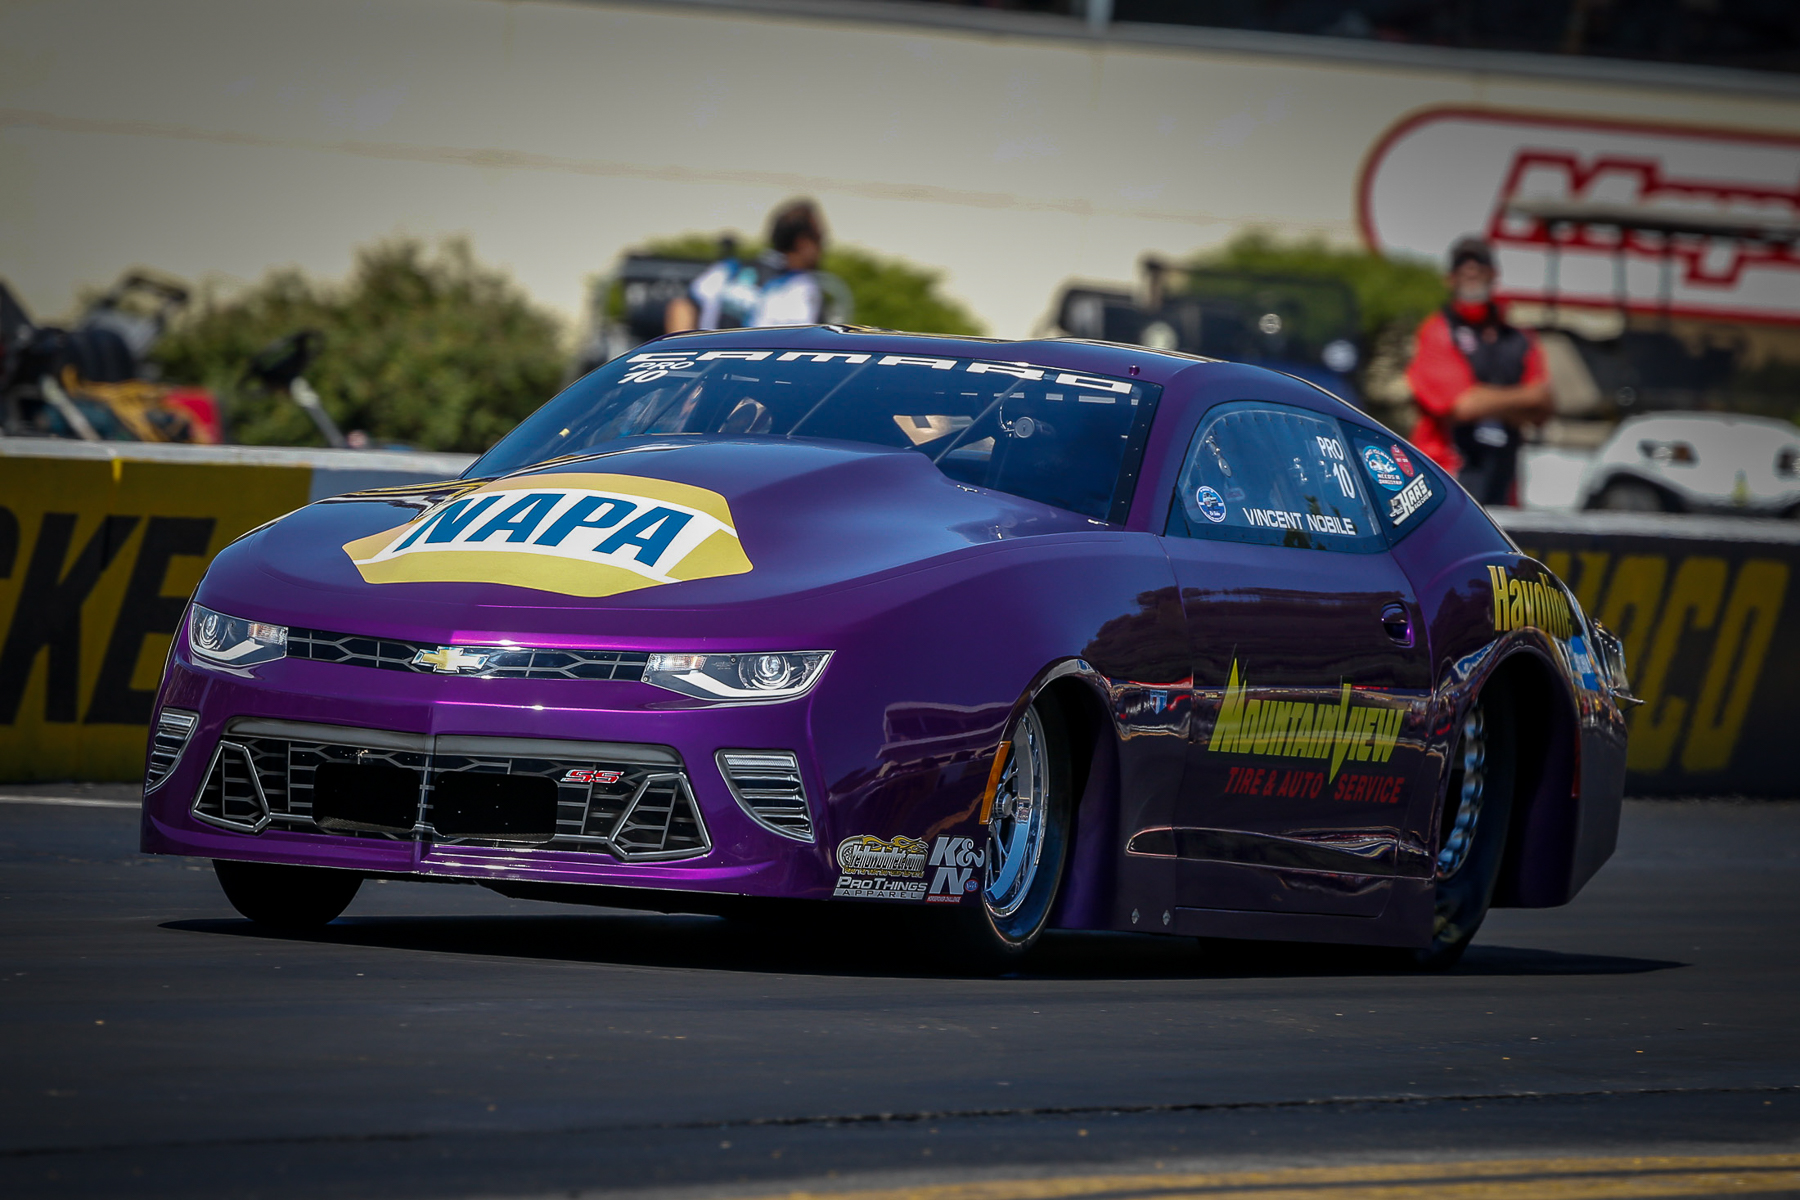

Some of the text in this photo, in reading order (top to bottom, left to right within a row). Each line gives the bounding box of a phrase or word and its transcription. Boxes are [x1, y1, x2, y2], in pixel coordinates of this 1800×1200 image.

[618, 370, 669, 384] 10
[626, 351, 1133, 395] CAMARO
[629, 361, 696, 372] PRO
[1316, 436, 1345, 461] PRO
[1333, 463, 1356, 499] 10
[392, 493, 695, 568] NAPA
[1242, 507, 1357, 536] VINCENT NOBILE
[0, 504, 218, 726] KE
[1487, 565, 1573, 641] Havoline
[560, 769, 625, 784] SS
[1224, 767, 1406, 804] TIRE & AUTO SERVICE
[842, 889, 918, 899] APPAREL
